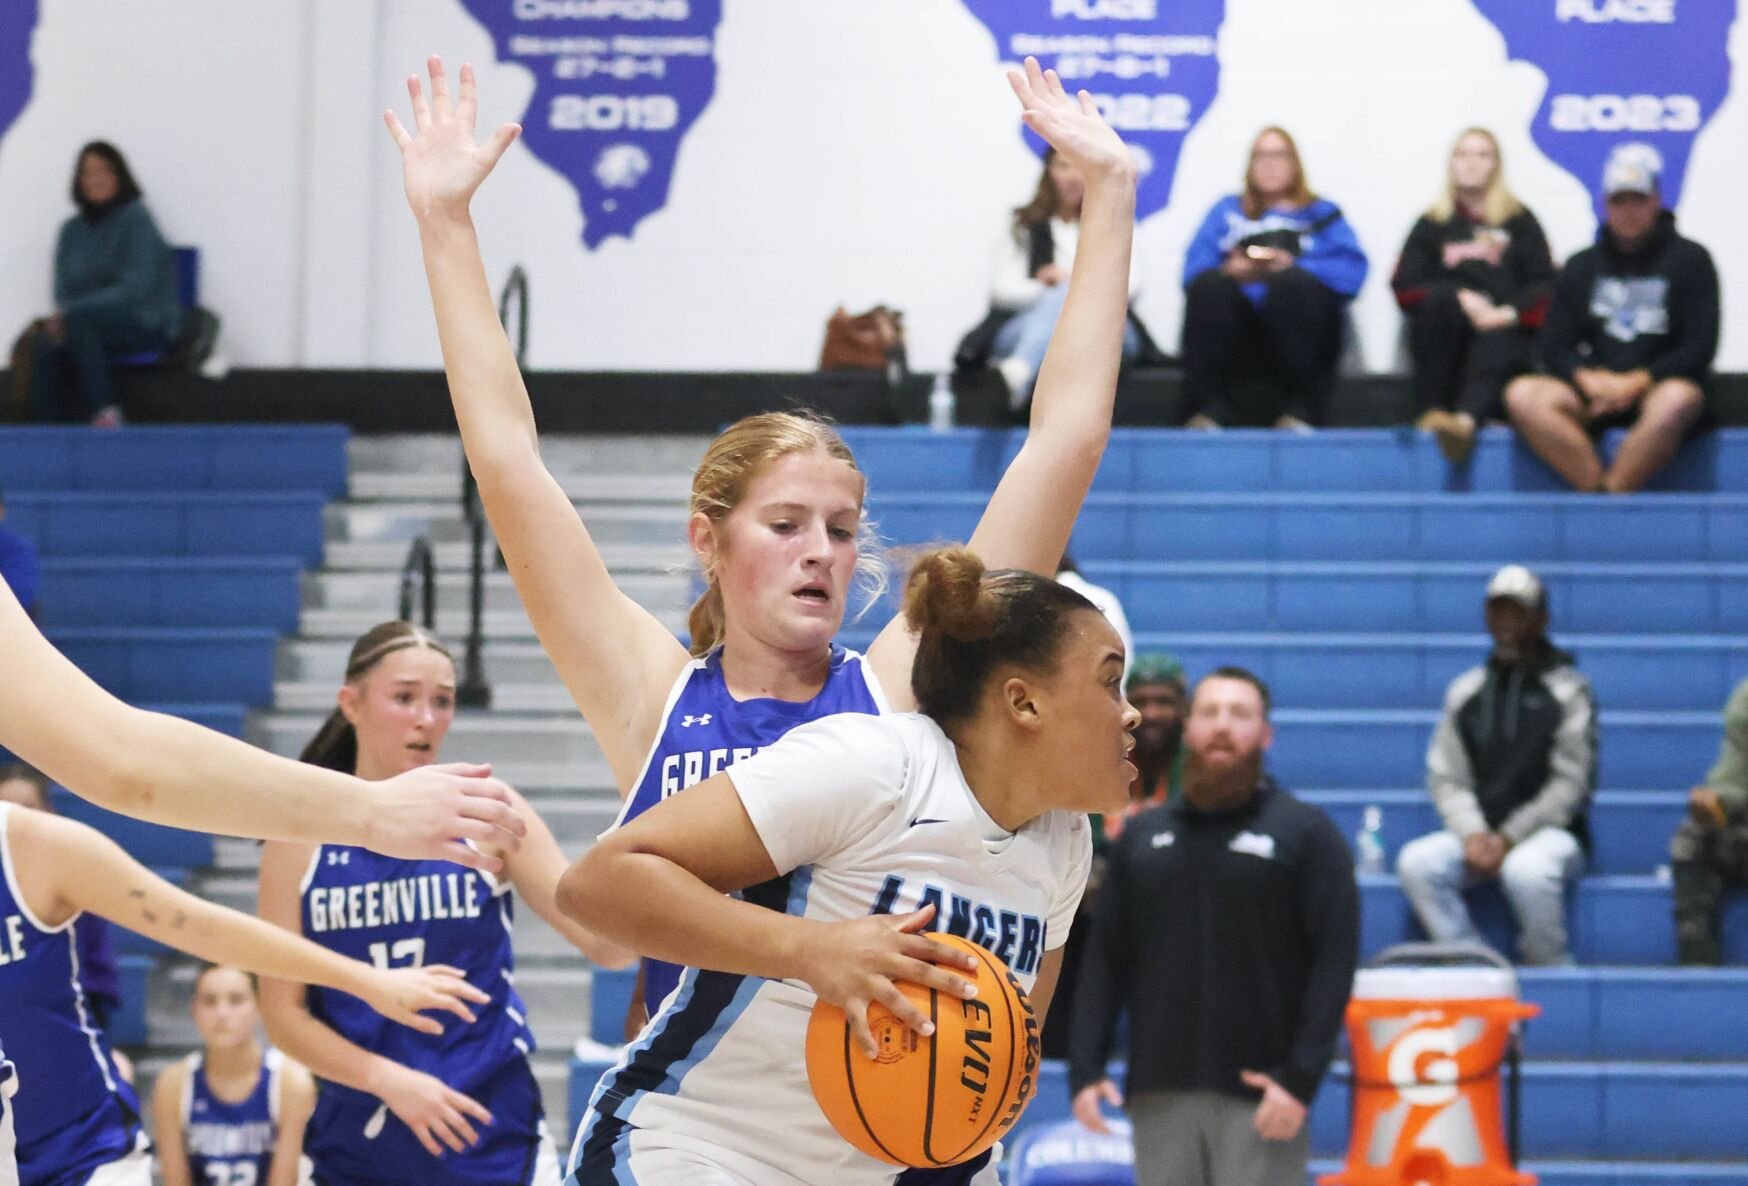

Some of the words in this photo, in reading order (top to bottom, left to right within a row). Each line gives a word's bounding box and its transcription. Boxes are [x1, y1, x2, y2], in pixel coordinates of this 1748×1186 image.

[548, 94, 679, 131] 2019
[1550, 94, 1700, 131] 2023
[310, 872, 480, 932] GREENVILLE
[951, 998, 992, 1095] EVO
[967, 1096, 984, 1124] NXT
